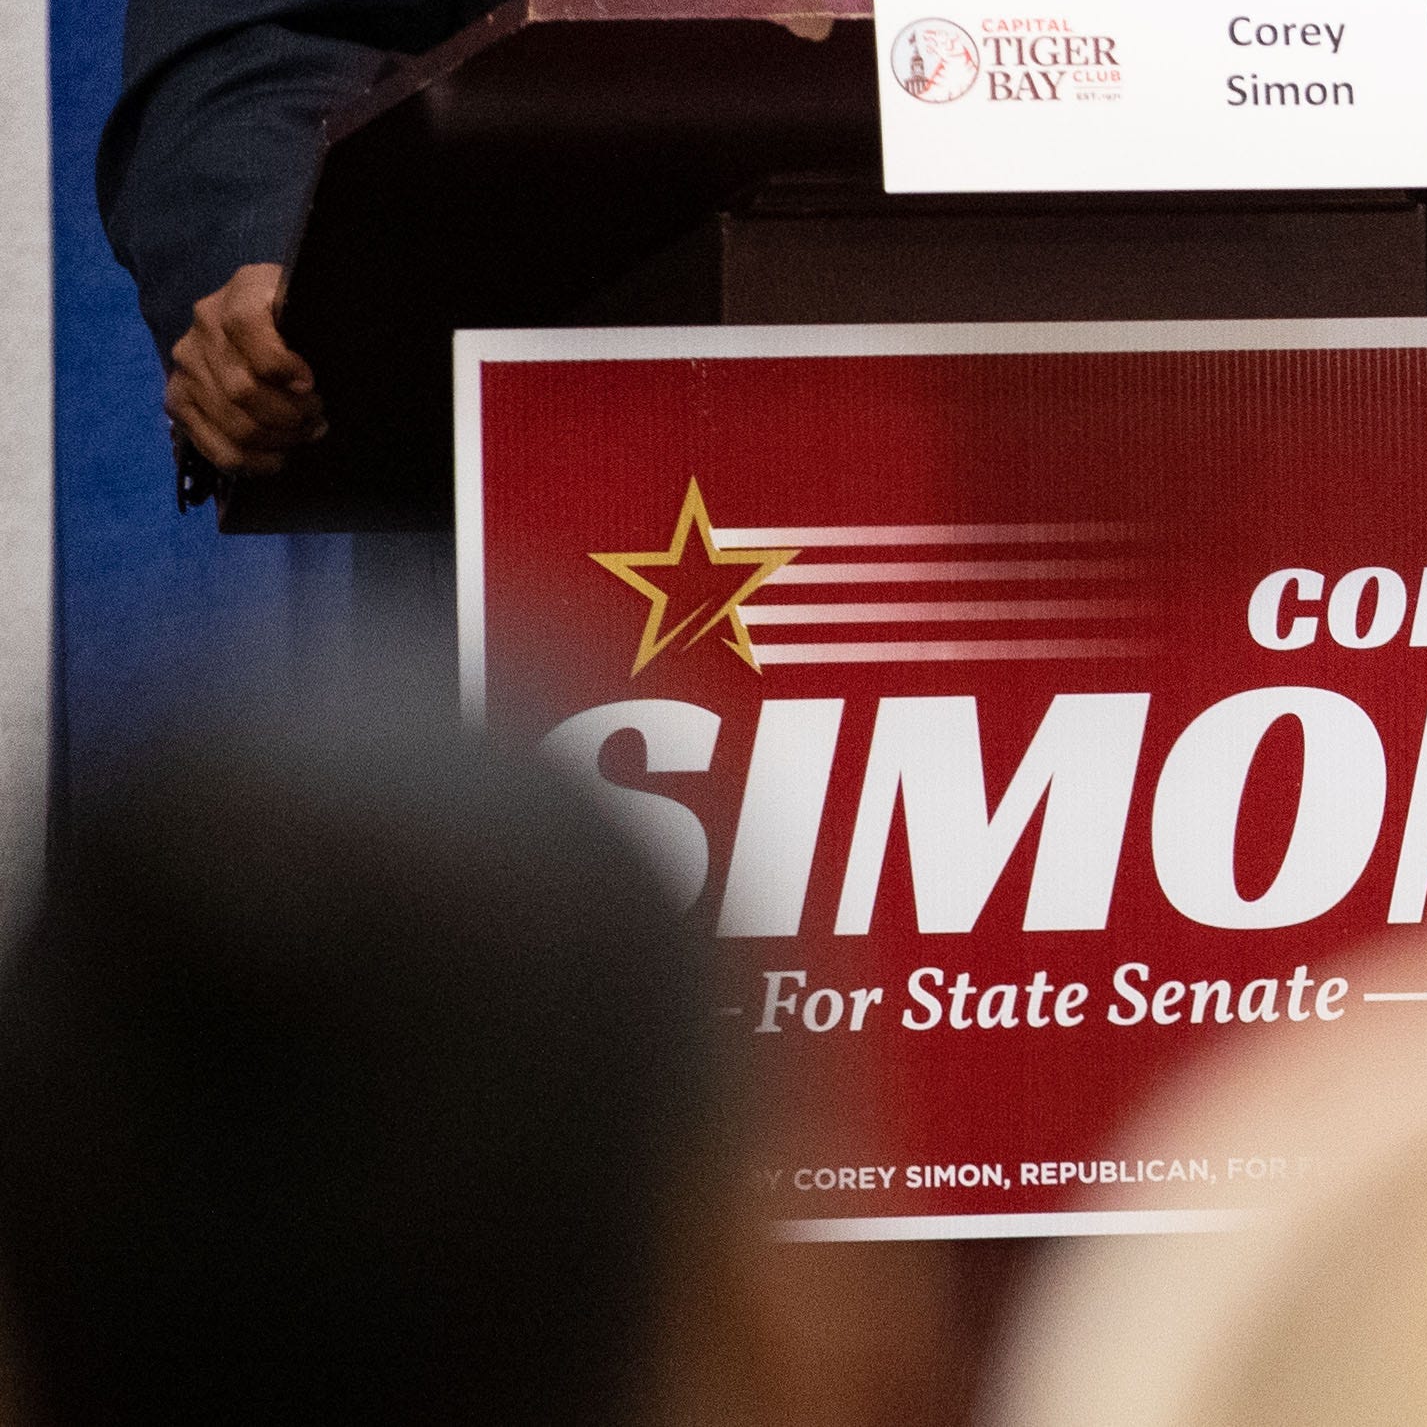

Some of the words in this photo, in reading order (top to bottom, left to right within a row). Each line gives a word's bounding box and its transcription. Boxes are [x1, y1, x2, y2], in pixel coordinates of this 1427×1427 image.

[981, 18, 1072, 33] CAPITAL
[1228, 16, 1345, 54] Corey
[983, 36, 1119, 66] TIGER
[987, 70, 1066, 101] BAY
[1072, 70, 1121, 83] CLUB
[1226, 74, 1355, 107] Simon
[755, 970, 884, 1035] For
[902, 966, 1088, 1031] State
[1108, 963, 1349, 1026] Senate
[794, 1166, 896, 1191] COREY
[906, 1163, 1011, 1190] SIMON,
[1020, 1158, 1217, 1187] REPUBLICAN,
